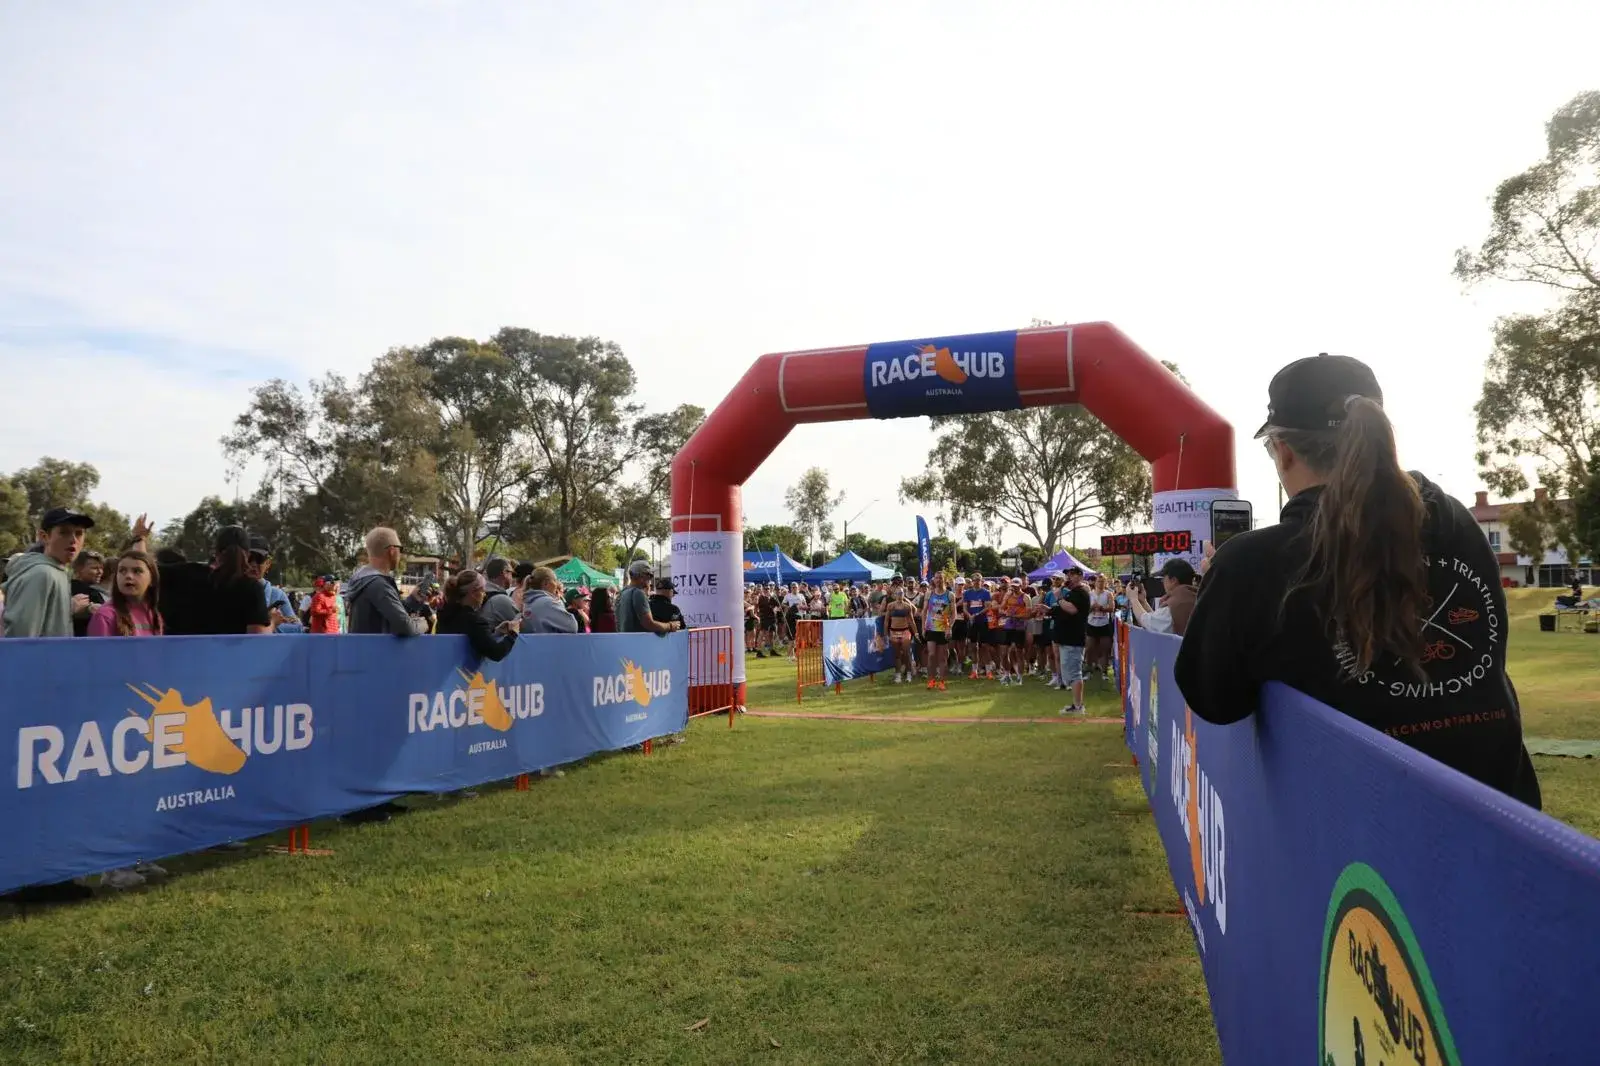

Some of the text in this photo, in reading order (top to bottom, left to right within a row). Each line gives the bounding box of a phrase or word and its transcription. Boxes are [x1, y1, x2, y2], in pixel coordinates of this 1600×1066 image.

[871, 351, 1005, 386] RACE HUB
[925, 388, 963, 396] AUSTRALIA
[1103, 532, 1189, 554] 00:00:00
[673, 573, 718, 587] CTIVE
[1453, 557, 1499, 643] TRIATHLON
[593, 669, 671, 708] RACE HUB
[1389, 654, 1493, 698] COACHING
[408, 683, 545, 734] RACE HUB
[17, 702, 314, 789] RACE HUB
[468, 739, 508, 754] AUSTRALIA
[155, 785, 236, 812] AUSTRALIA
[1197, 762, 1226, 936] HUB
